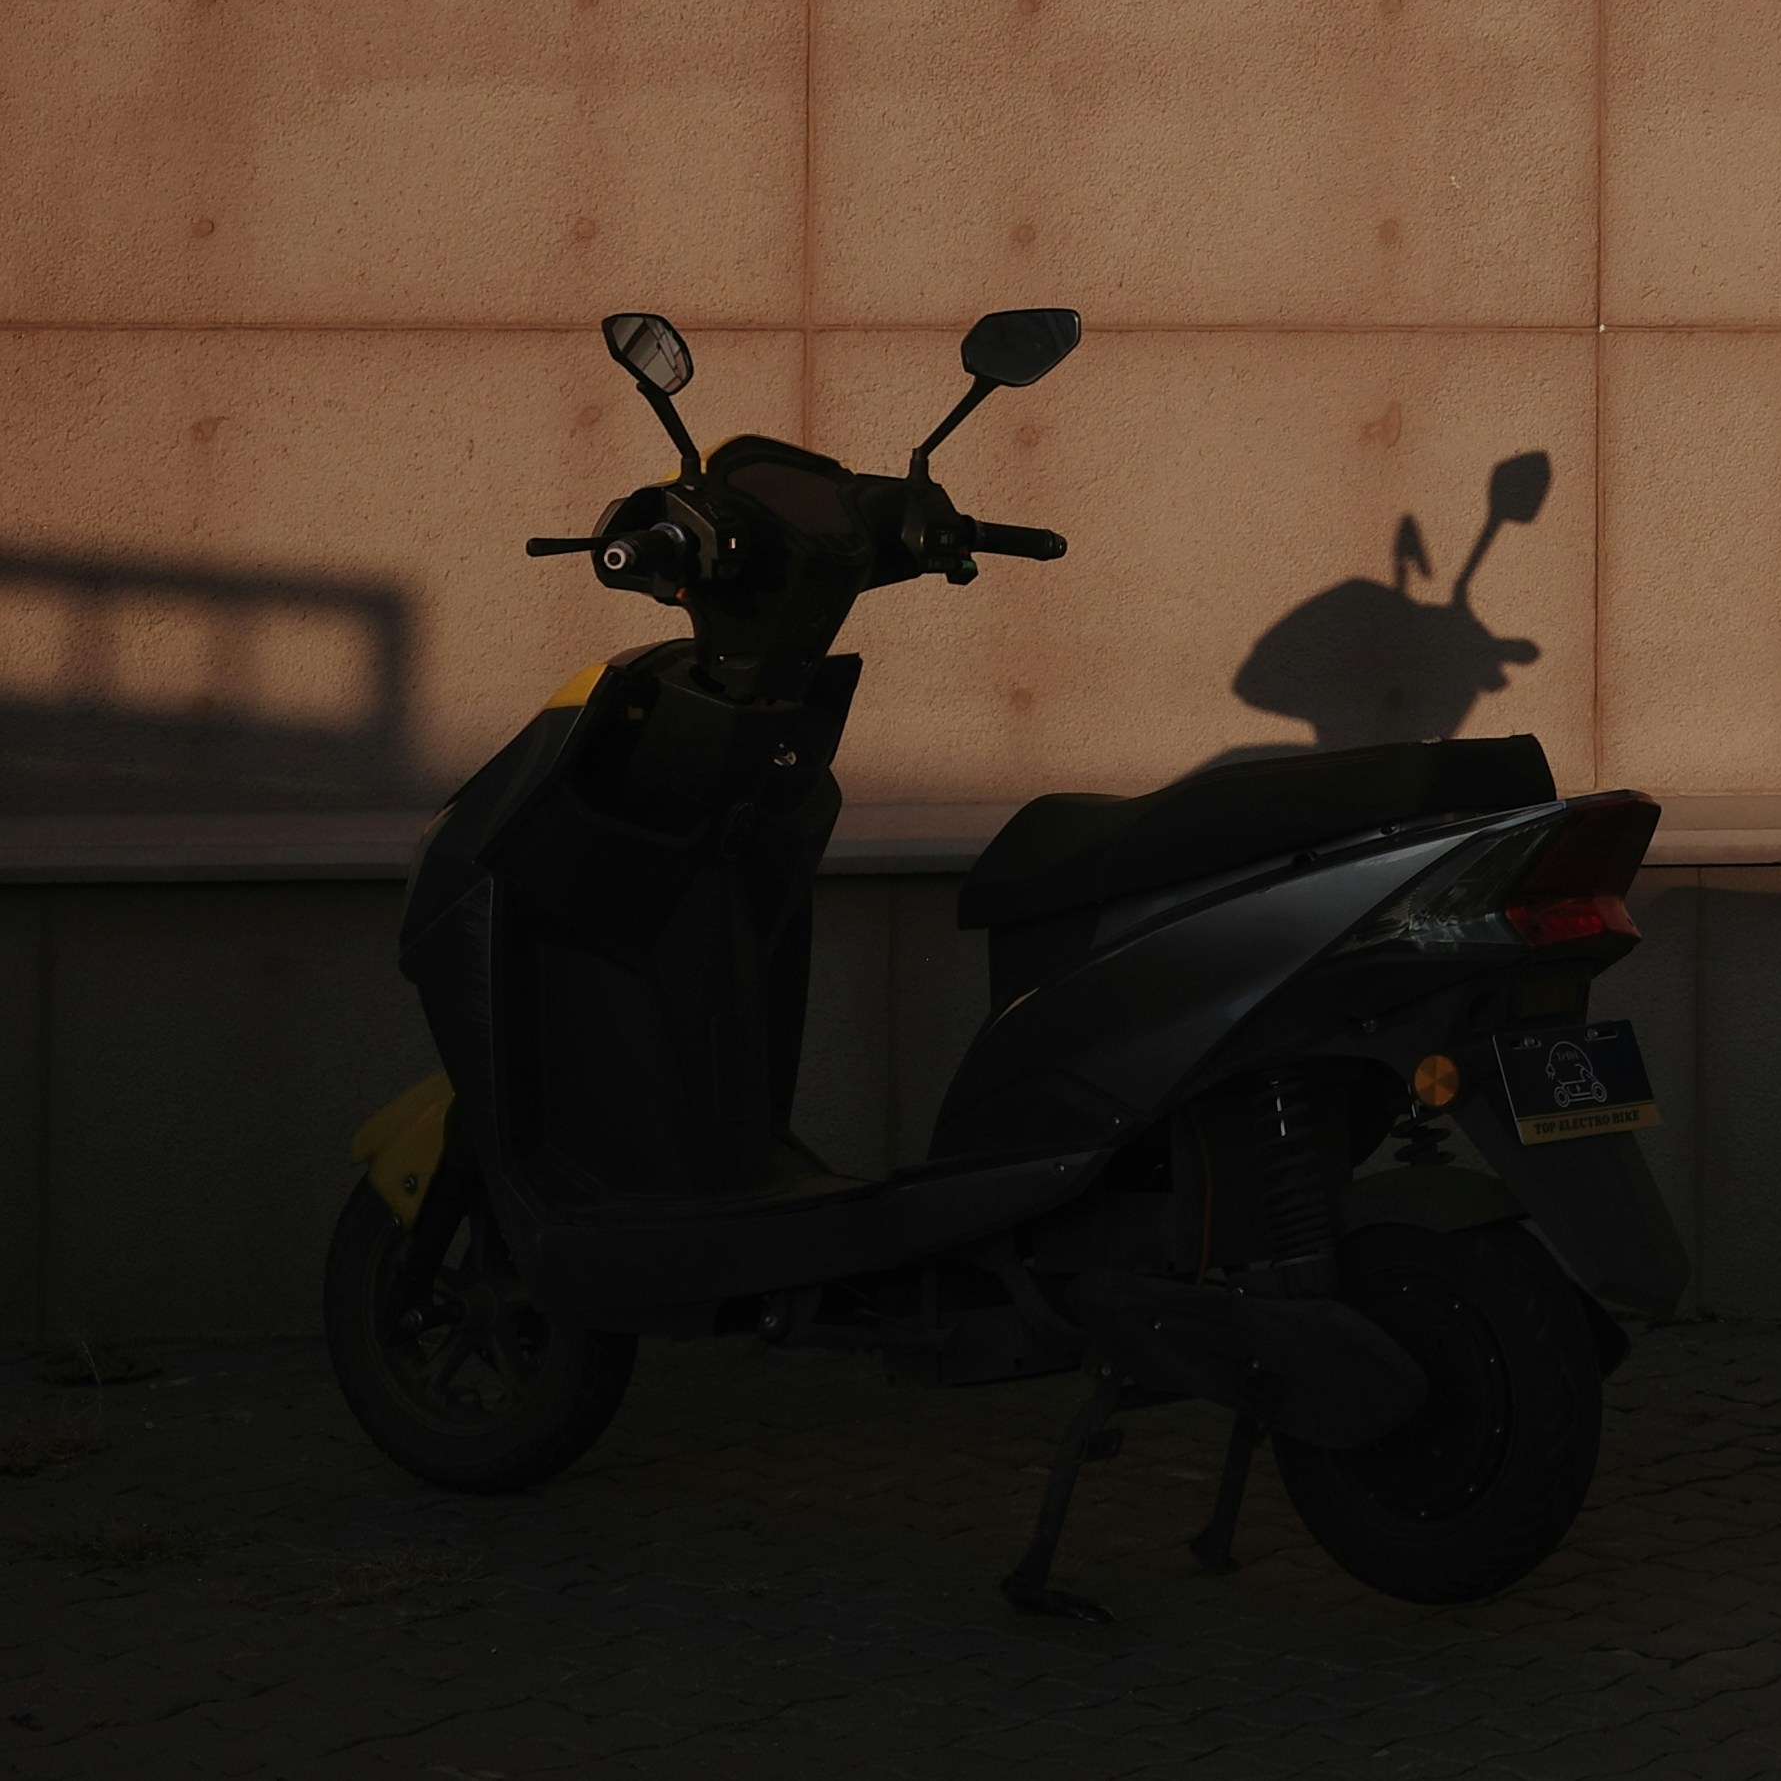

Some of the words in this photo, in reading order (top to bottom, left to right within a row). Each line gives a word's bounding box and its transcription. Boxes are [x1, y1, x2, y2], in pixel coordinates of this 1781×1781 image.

[1533, 1123, 1557, 1135] TOP
[1559, 1114, 1611, 1132] ELECTRO
[1612, 1109, 1641, 1124] BIKE
